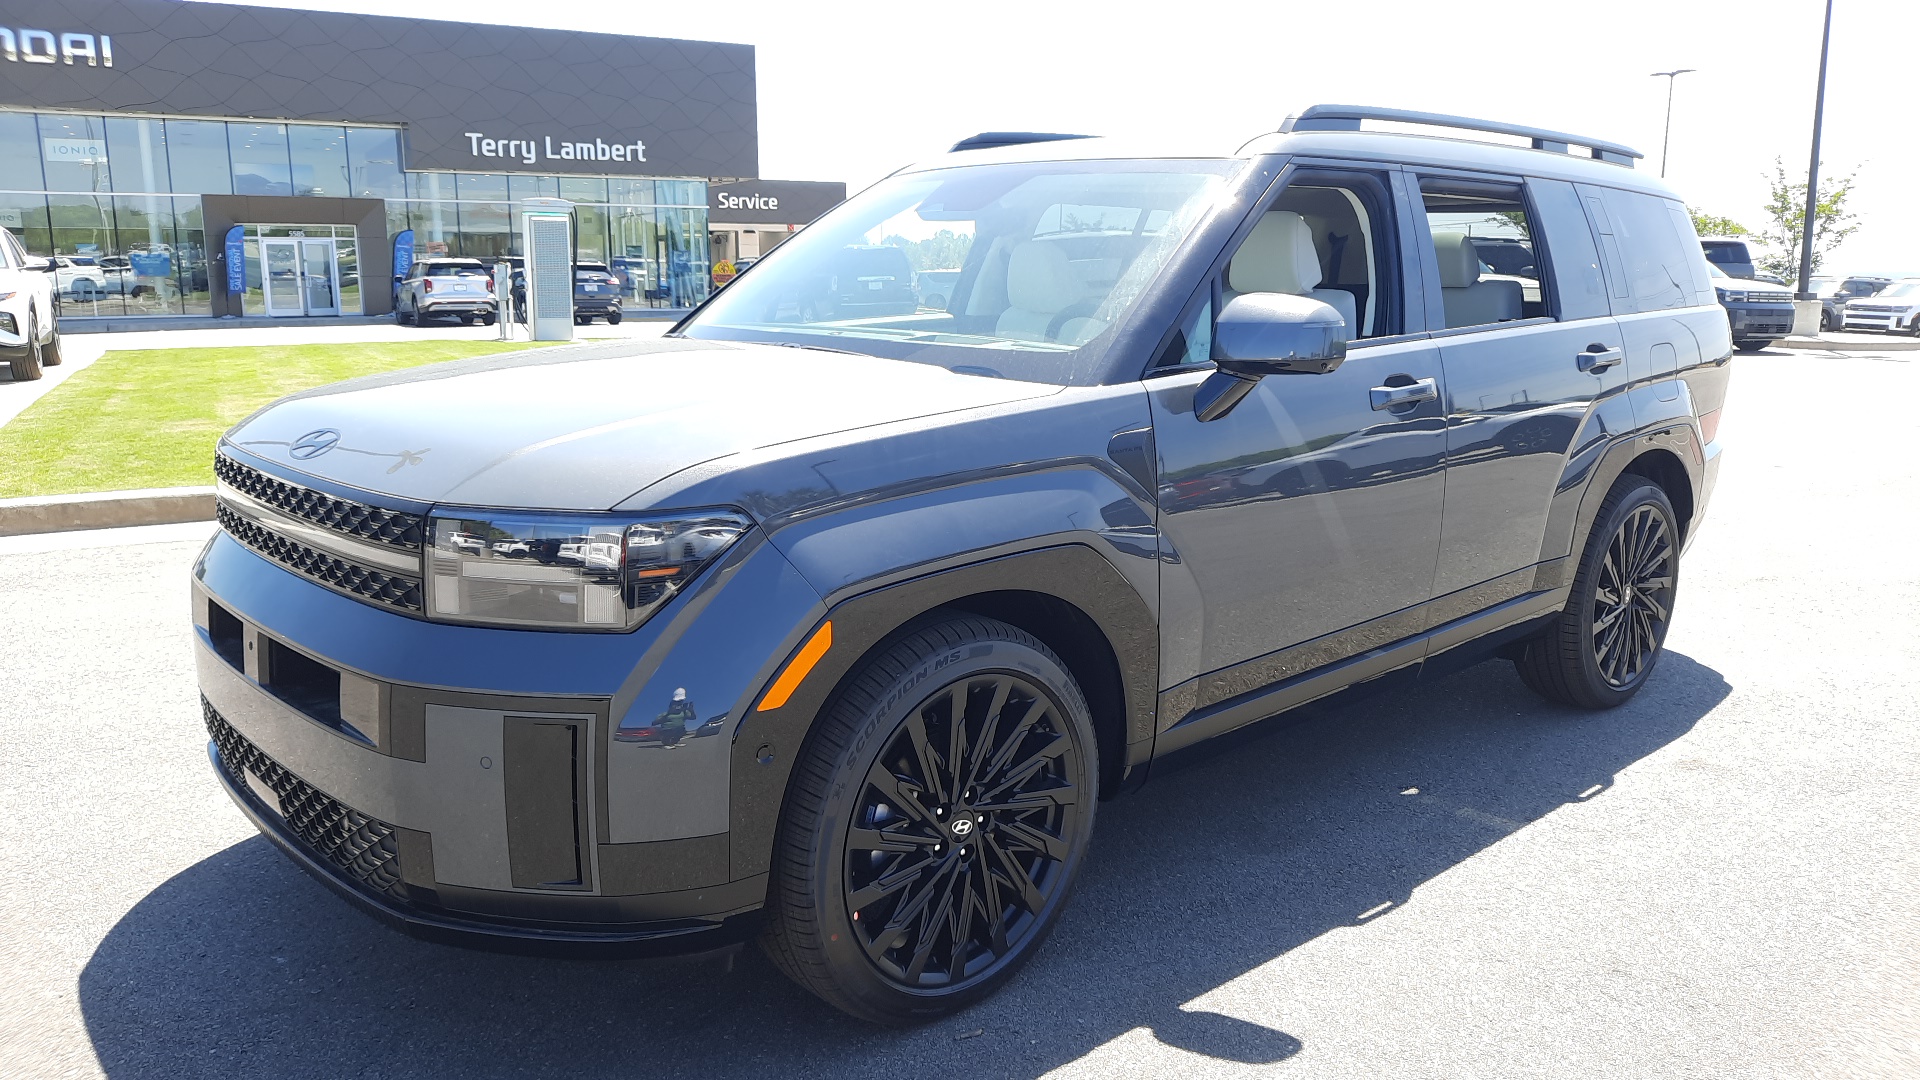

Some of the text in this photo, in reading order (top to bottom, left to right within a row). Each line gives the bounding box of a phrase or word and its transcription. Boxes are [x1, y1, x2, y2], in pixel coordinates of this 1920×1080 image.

[464, 132, 647, 164] Terry Lambert
[717, 192, 778, 210] Service
[232, 248, 242, 272] EVENT
[233, 273, 242, 291] SALE
[846, 650, 961, 771] SCORPION MS
